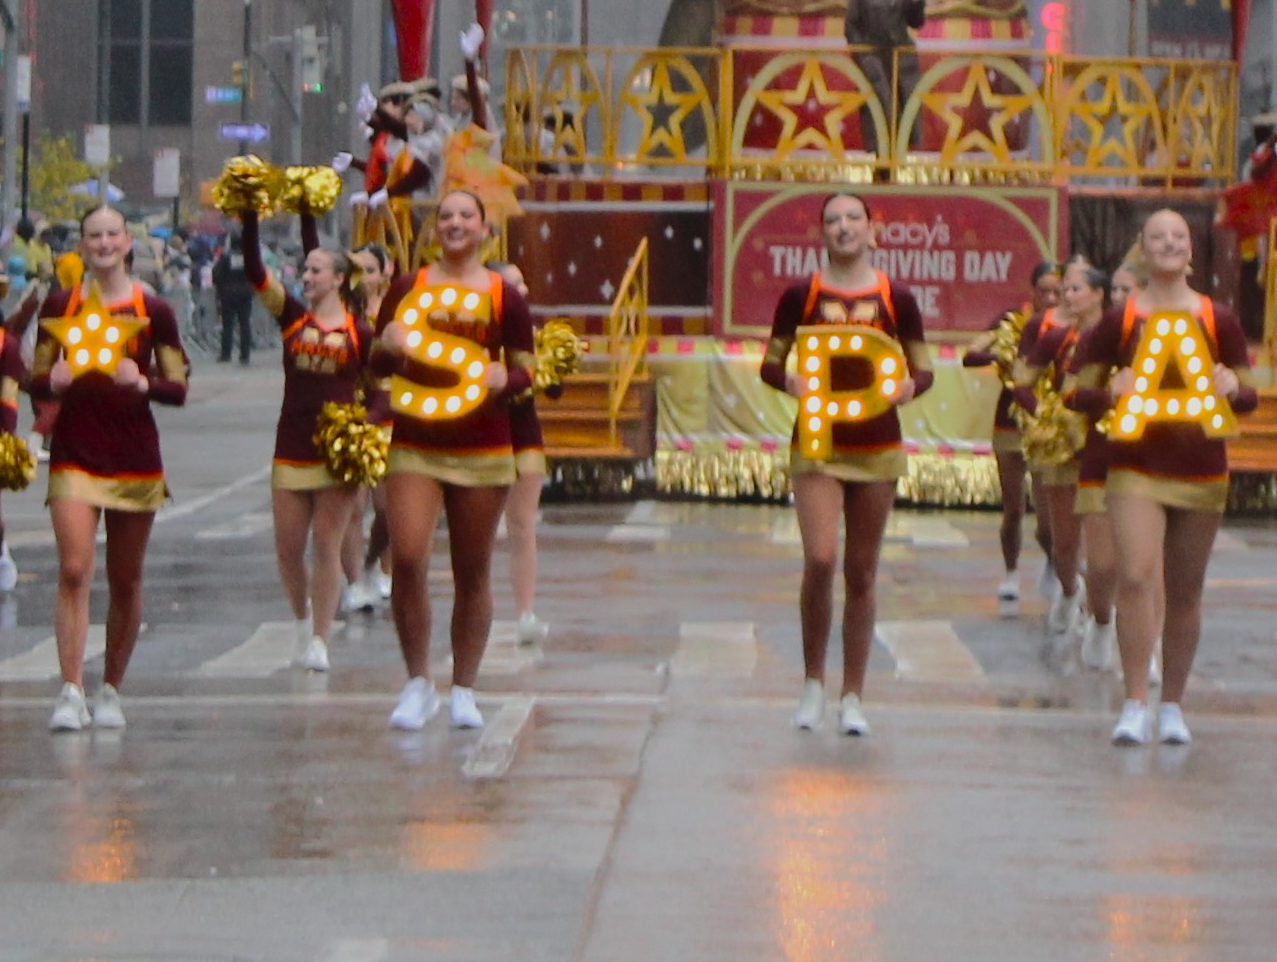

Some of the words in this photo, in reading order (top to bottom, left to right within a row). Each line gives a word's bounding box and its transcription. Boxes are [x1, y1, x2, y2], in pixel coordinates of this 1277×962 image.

[769, 245, 956, 283] THAGIVING
[963, 249, 1013, 283] DAY
[389, 283, 491, 421] S
[795, 325, 910, 460] P
[1106, 310, 1237, 440] A
